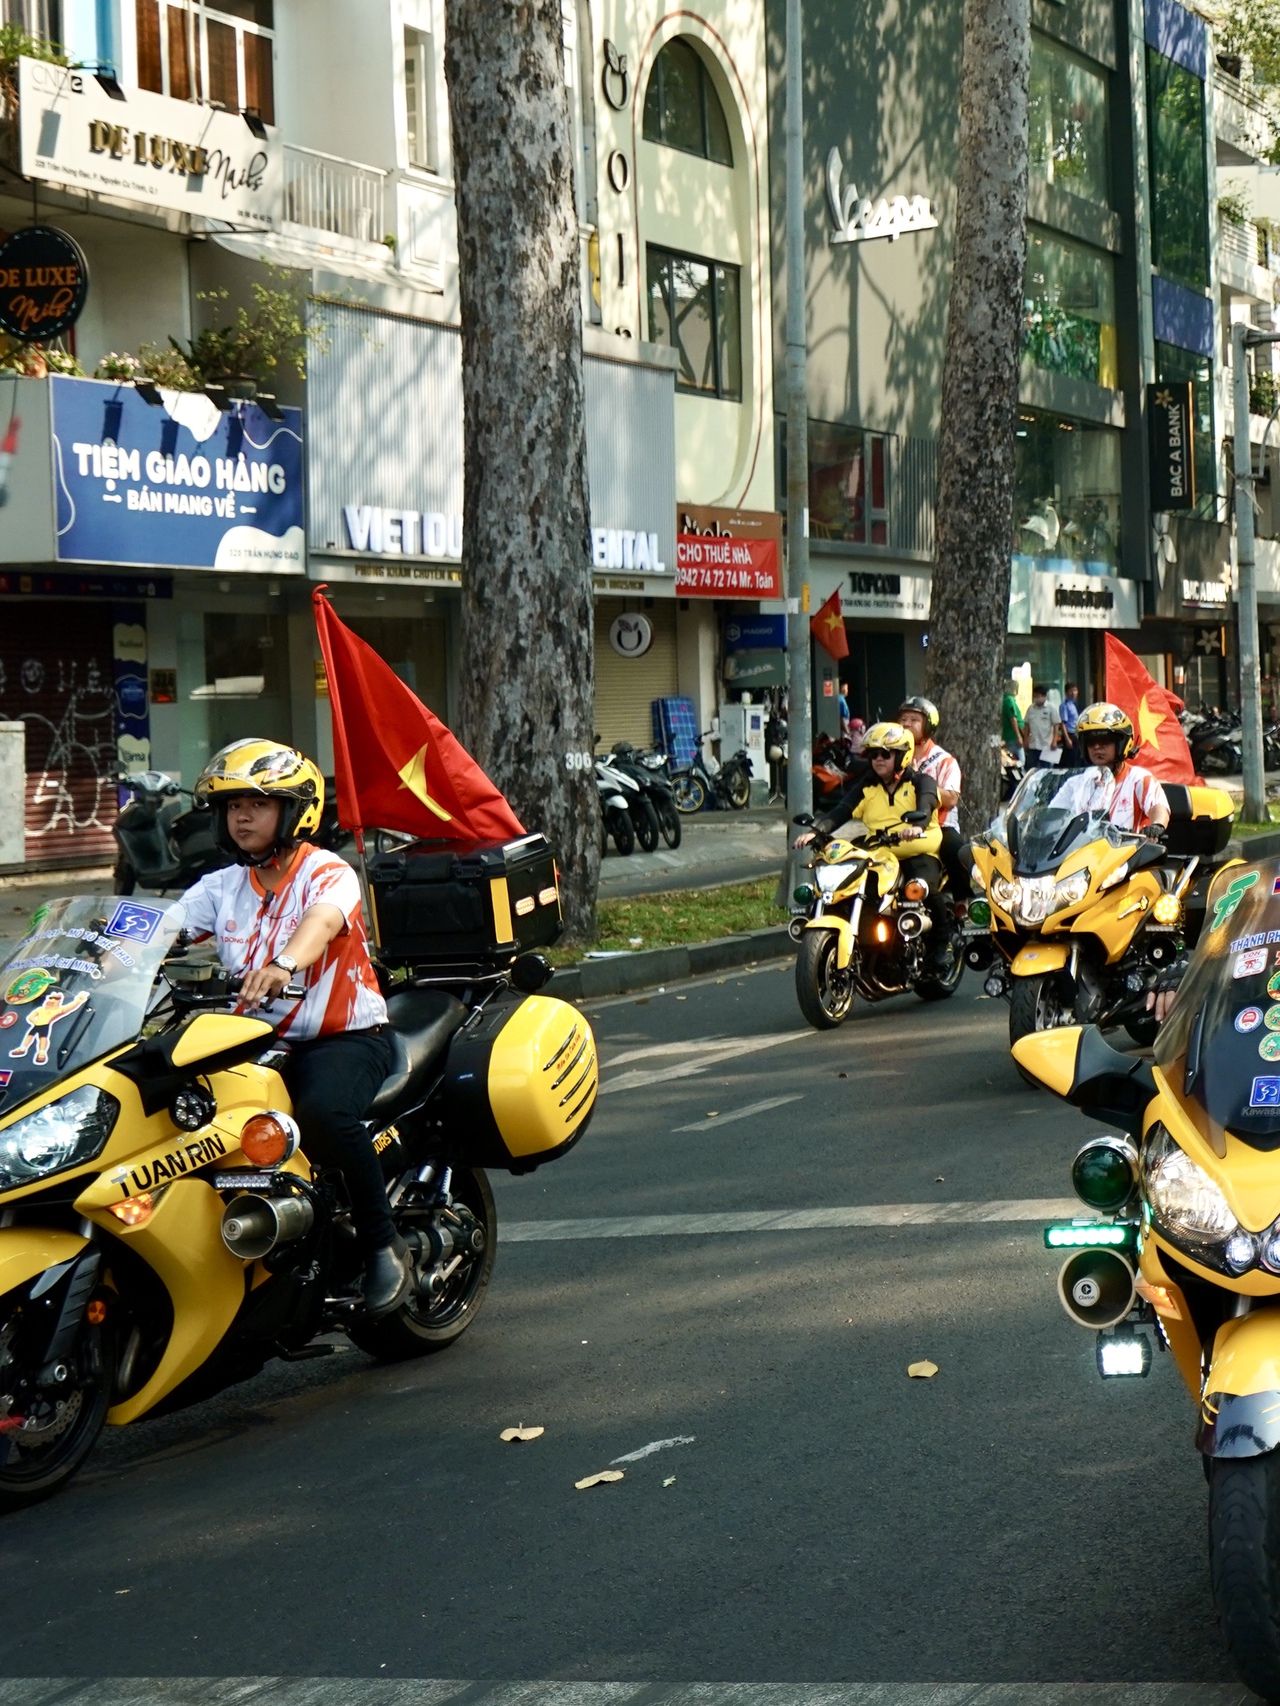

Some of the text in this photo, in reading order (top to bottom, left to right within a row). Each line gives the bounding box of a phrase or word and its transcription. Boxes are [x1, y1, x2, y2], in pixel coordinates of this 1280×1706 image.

[88, 119, 268, 199] DE LUXE Nails
[25, 266, 78, 286] LUXE
[9, 287, 73, 331] Nails
[1168, 403, 1183, 497] BAC A BANK
[72, 437, 141, 492] TIỆM
[215, 452, 286, 494] HÀNG
[127, 485, 236, 518] BÁN MANG VỀ
[344, 504, 665, 572] VIET DU ENTAL
[677, 541, 753, 565] CHO THUÊ NHÀ
[675, 567, 698, 587] 0942
[700, 569, 712, 588] 74
[713, 569, 725, 588] 72
[726, 570, 738, 588] 74
[739, 571, 753, 589] Mr.
[565, 751, 592, 770] 306
[112, 945, 136, 967] THAO
[1230, 935, 1266, 954] THÀNH
[1243, 950, 1261, 959] VOH
[70, 959, 98, 973] MINH
[110, 1133, 227, 1198] TUAN RIN
